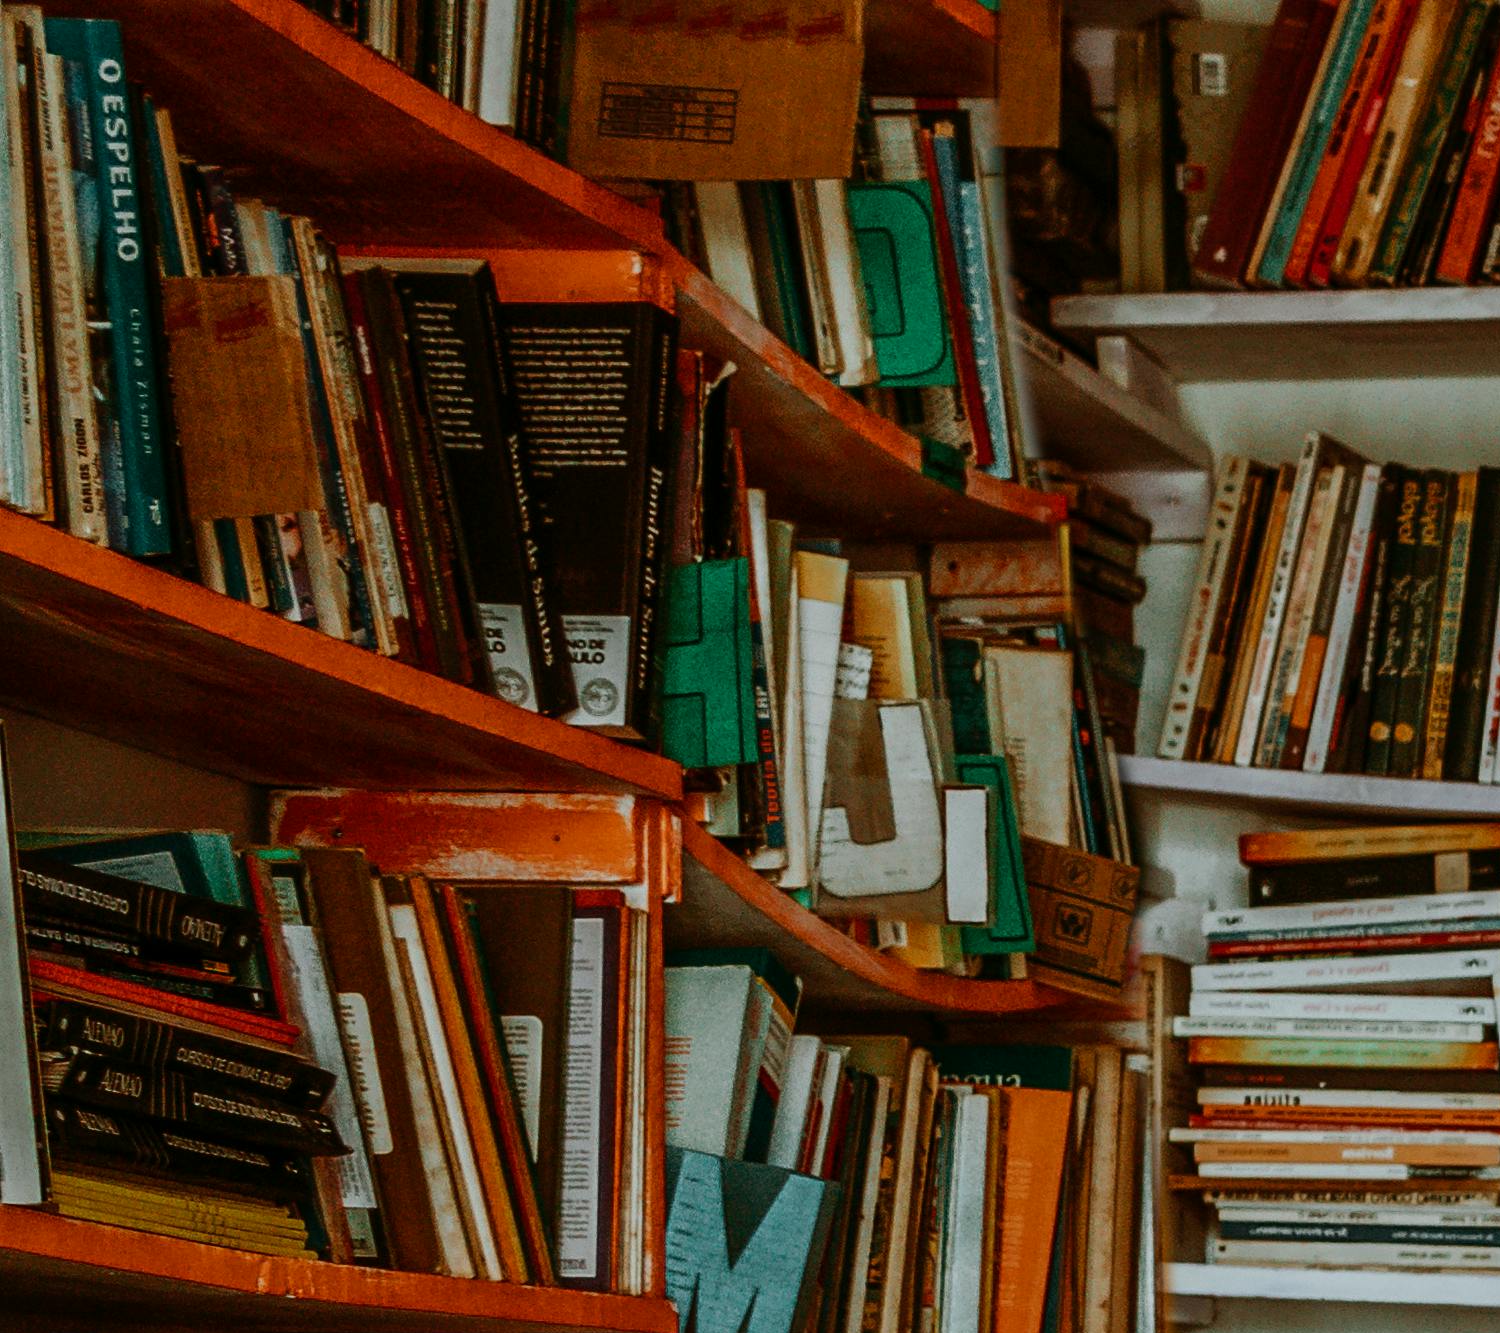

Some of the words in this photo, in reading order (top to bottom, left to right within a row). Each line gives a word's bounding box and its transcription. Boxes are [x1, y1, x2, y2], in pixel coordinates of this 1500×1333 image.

[98, 59, 121, 83] O
[101, 93, 140, 262] ESPELHO
[81, 463, 94, 514] CARLOS
[646, 467, 662, 558] Bondes
[643, 564, 655, 599] de
[532, 574, 553, 667] Santos
[639, 607, 655, 689] Santos
[84, 1020, 124, 1048] ALEMÃO
[176, 1048, 212, 1069] CURSOS
[101, 1069, 143, 1098] ALEMÃO
